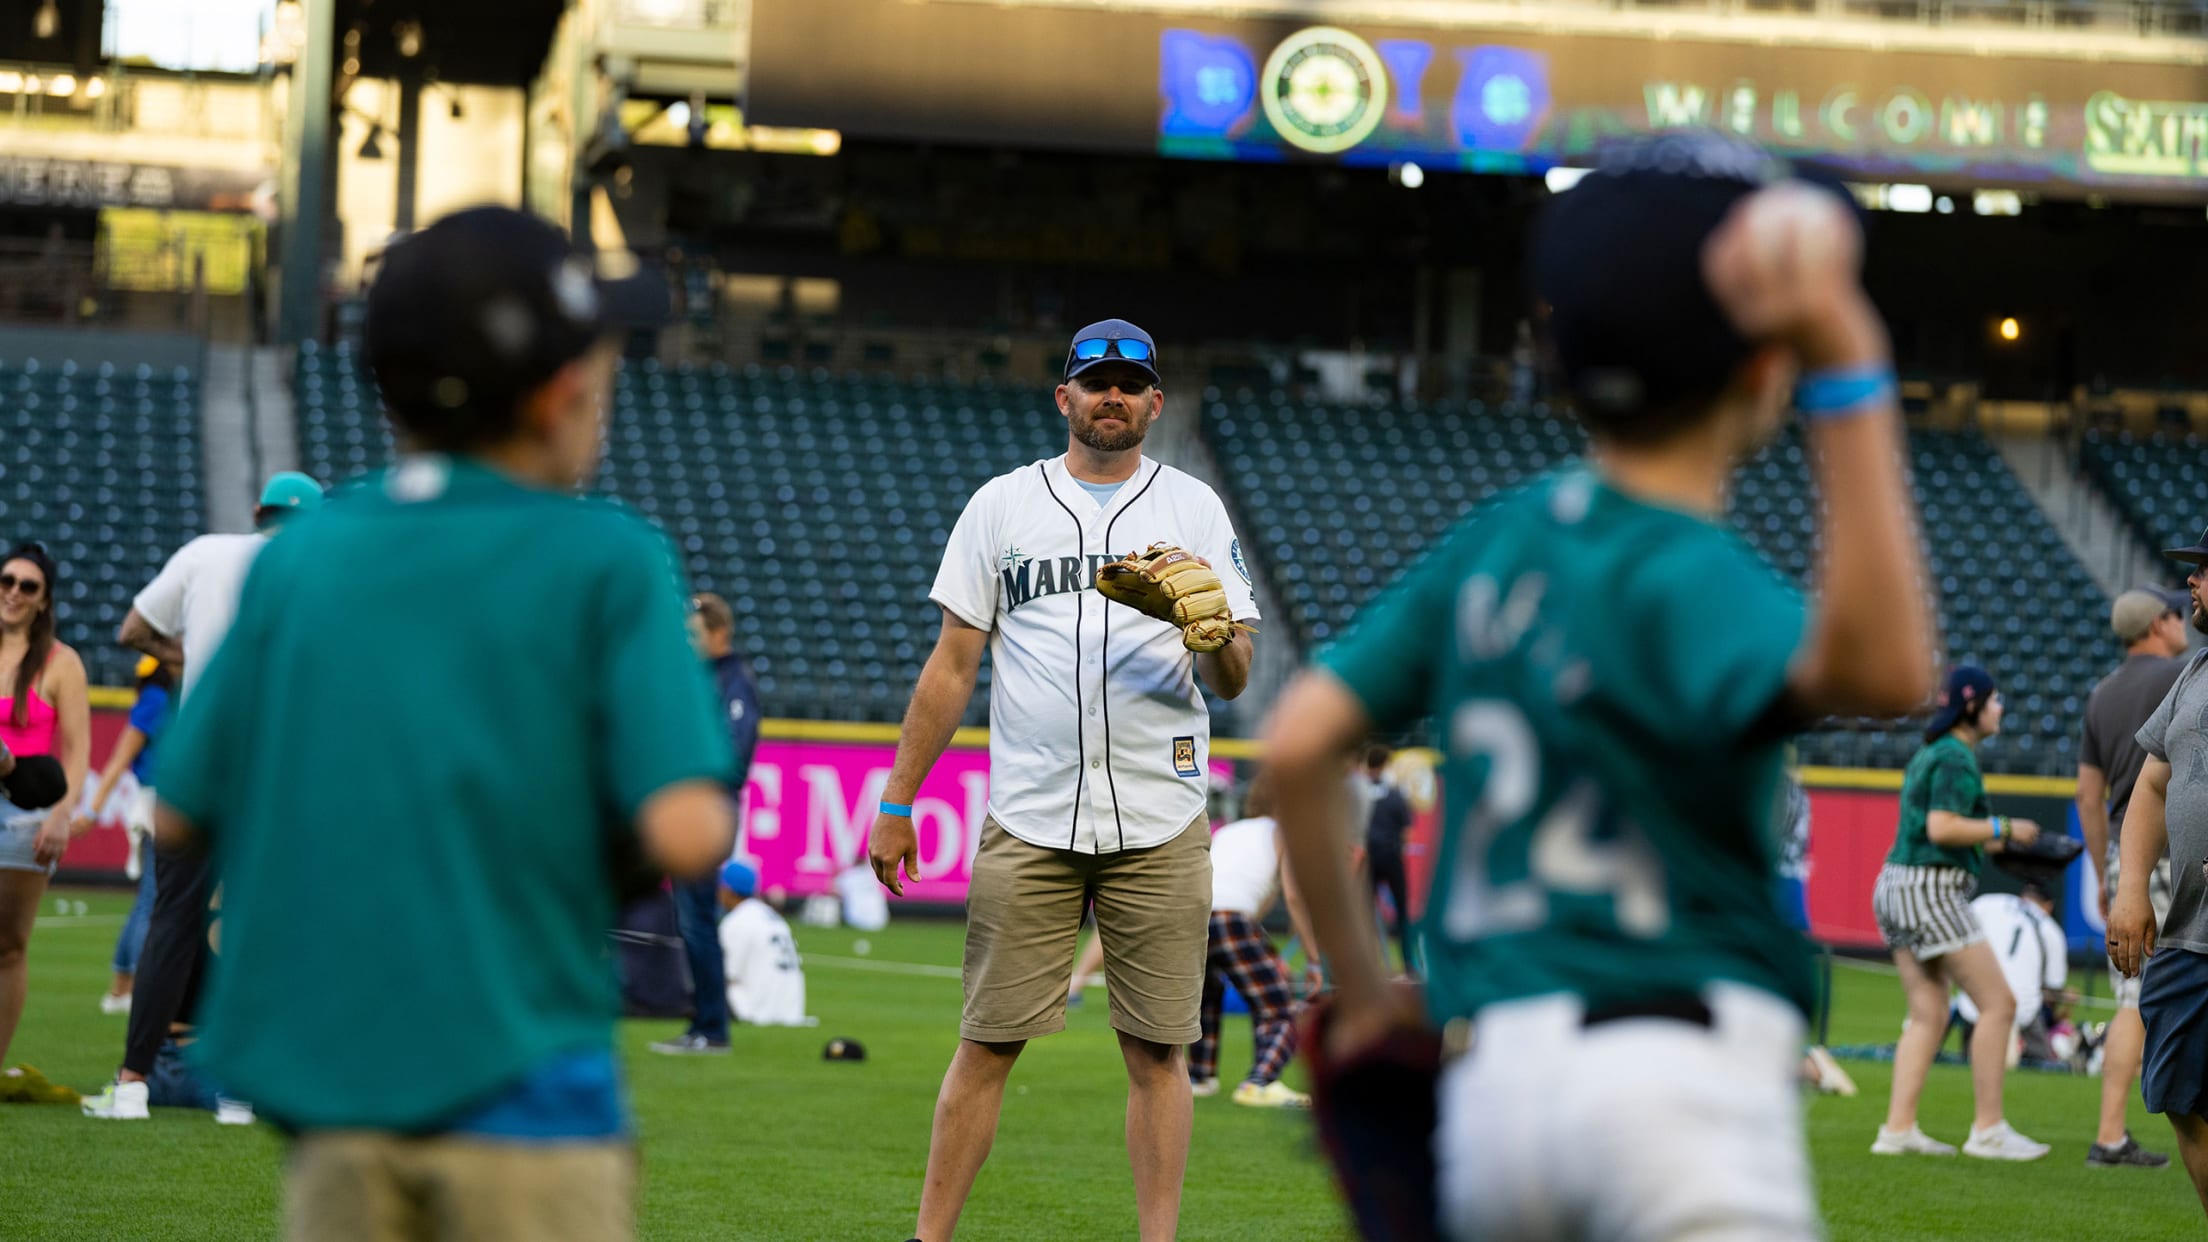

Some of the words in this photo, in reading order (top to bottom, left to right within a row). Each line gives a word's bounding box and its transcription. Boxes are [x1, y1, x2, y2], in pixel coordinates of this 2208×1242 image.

[1643, 81, 2048, 150] WELCOME
[1002, 554, 1129, 614] MARI
[1444, 699, 1671, 941] 24
